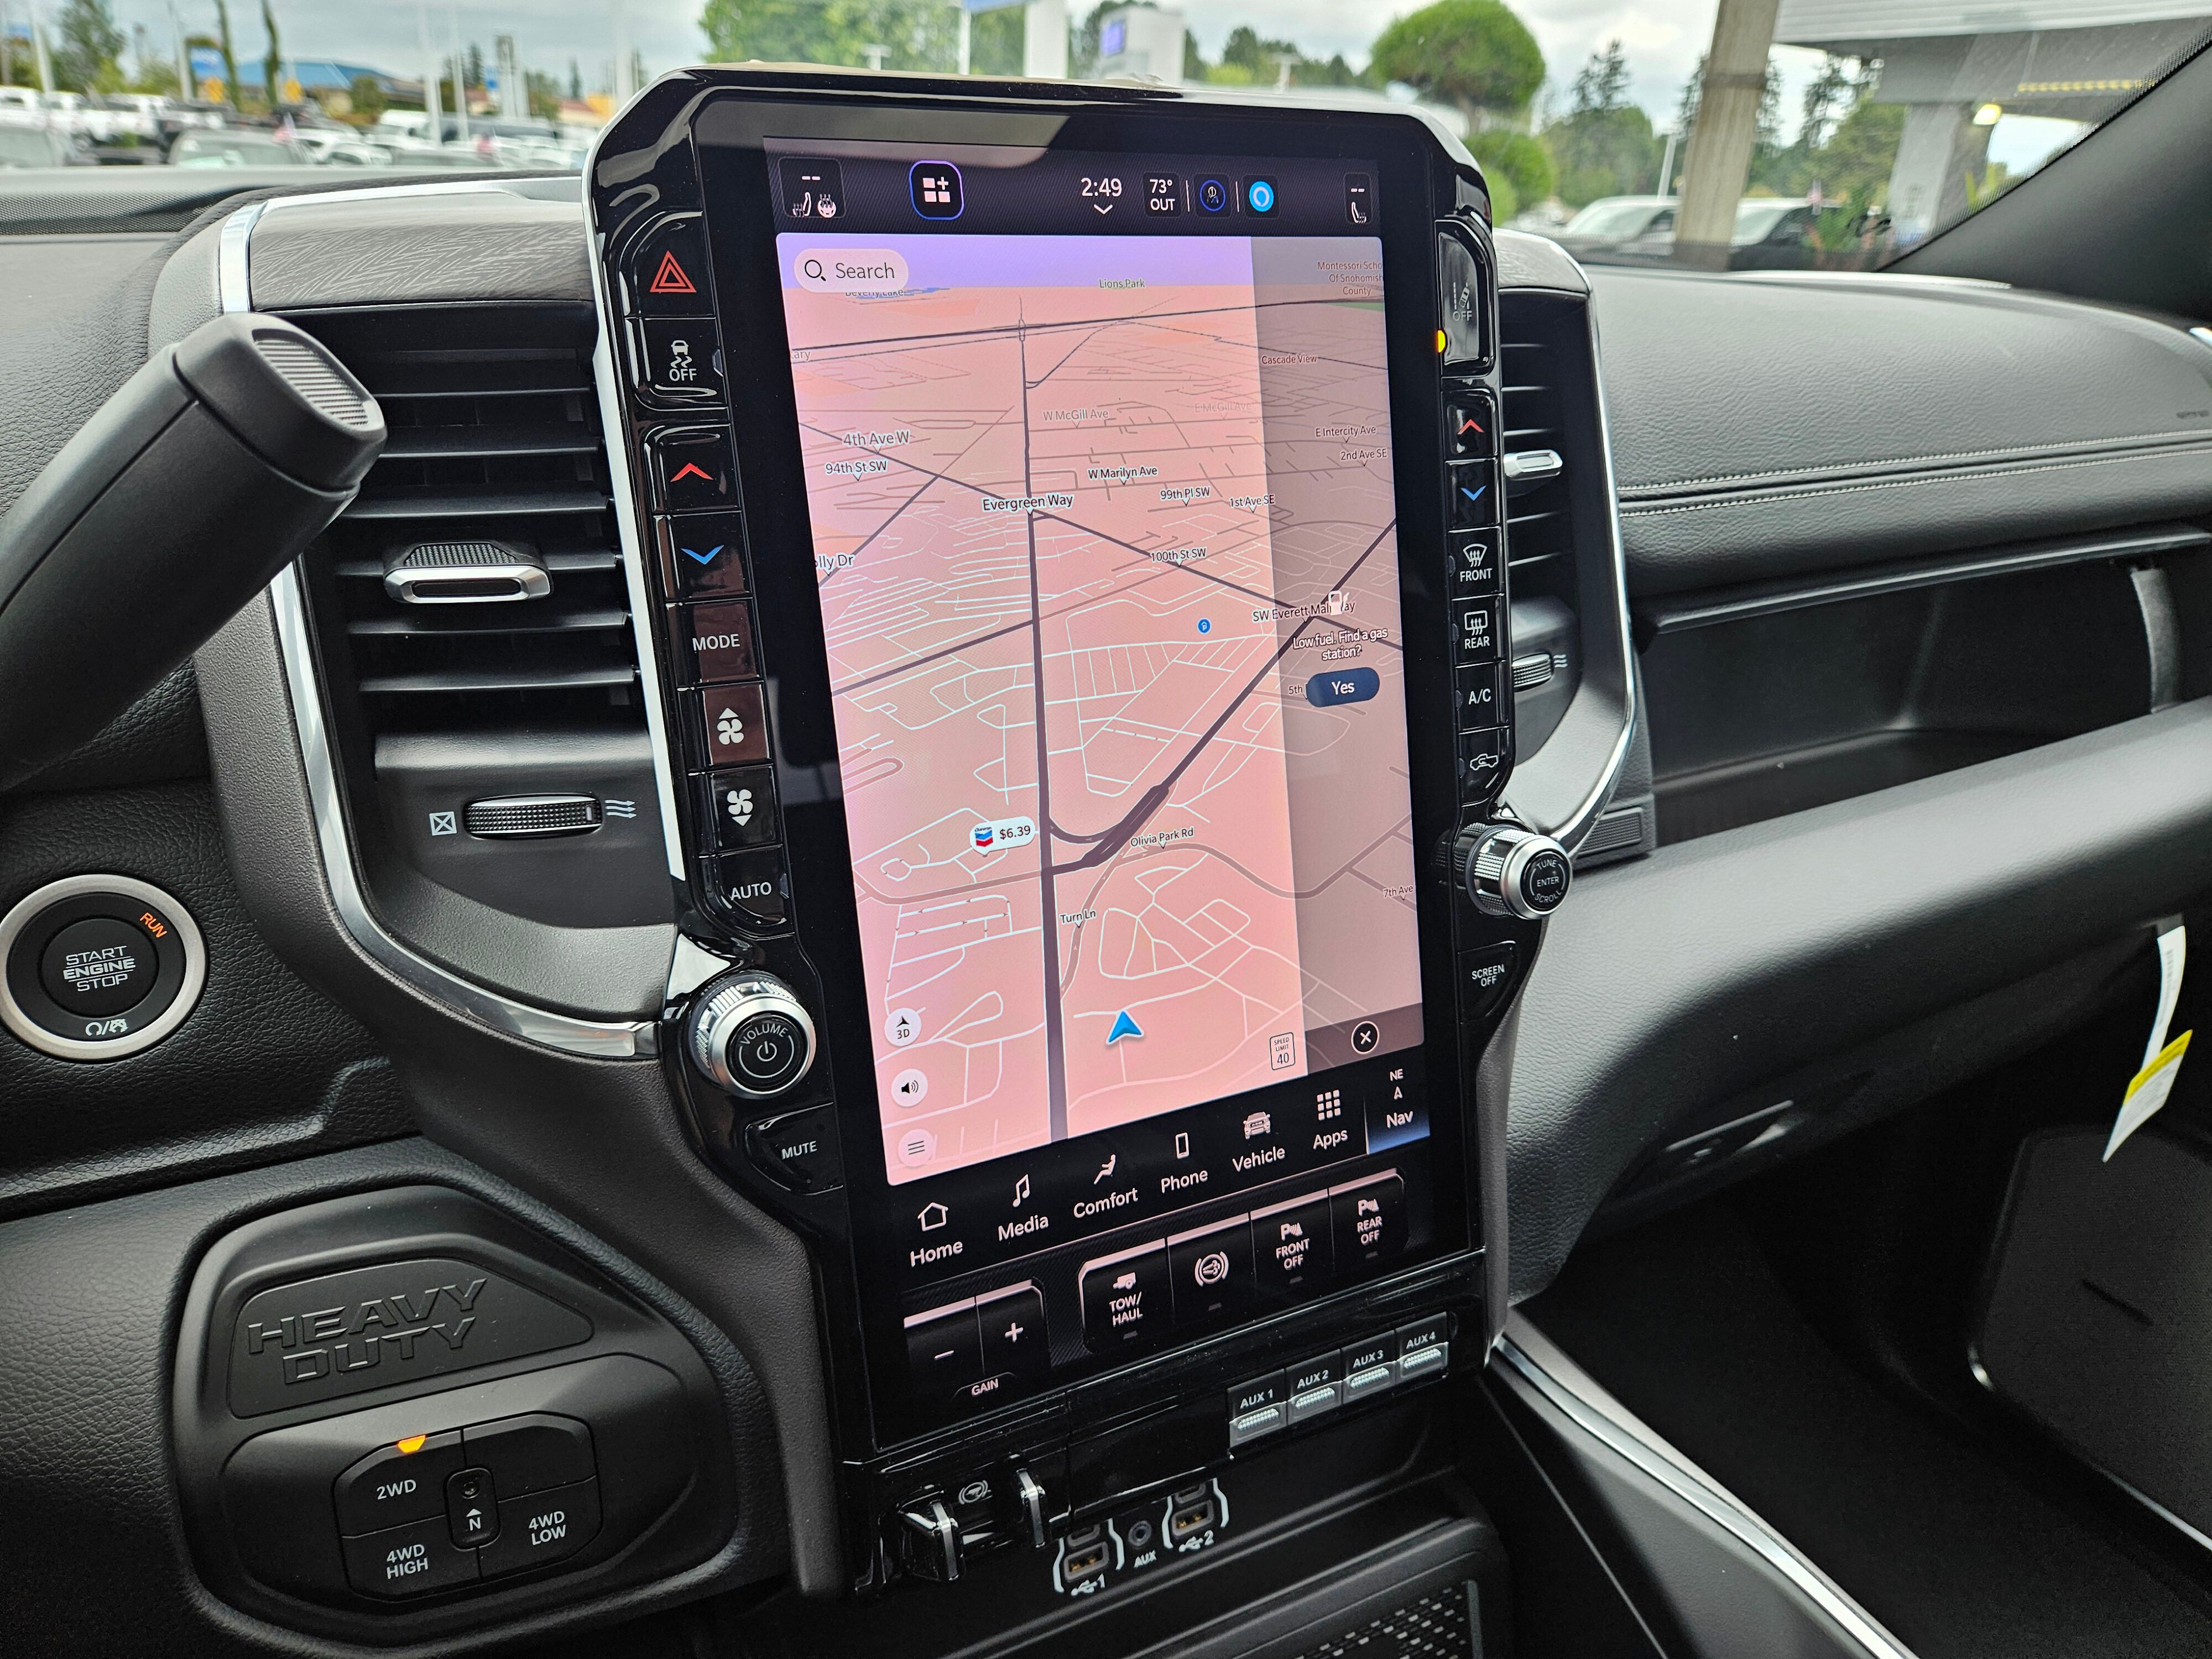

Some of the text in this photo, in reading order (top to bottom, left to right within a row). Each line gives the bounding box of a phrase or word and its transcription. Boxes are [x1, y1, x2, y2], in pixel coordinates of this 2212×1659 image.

[1081, 178, 1122, 197] 2:49
[1150, 198, 1175, 211] OUT
[836, 262, 895, 279] Search
[1318, 261, 1361, 270] Montessori
[1099, 278, 1145, 288] Lions Park
[1329, 274, 1339, 283] Of
[1343, 286, 1371, 296] County
[1453, 310, 1472, 322] OFF
[1262, 354, 1317, 364] Cascade View
[669, 368, 697, 382] OFF
[1044, 409, 1109, 421] W McGill Ave
[843, 431, 909, 445] 4th Ave W
[1316, 425, 1376, 439] E Intercity Ave
[1341, 448, 1387, 460] 2nd Ave SE
[826, 461, 887, 474] 94th St SW
[1088, 466, 1157, 479] W Marilyn Ave
[1161, 487, 1210, 499] 99th Pl SW
[1230, 494, 1275, 507] 1st Ave SE
[983, 494, 1073, 512] Evergreen Way
[838, 554, 853, 566] Dr
[1151, 548, 1207, 562] 100th St SW
[1459, 568, 1493, 583] FRONT
[1253, 611, 1269, 622] SW
[1272, 606, 1308, 620] Everett
[692, 634, 740, 651] MODE
[1293, 628, 1388, 649] Low fuel. Find a gas
[1464, 636, 1490, 649] REAR
[1322, 644, 1362, 661] station?
[1289, 685, 1303, 695] 5th
[1332, 680, 1355, 695] Yes
[1468, 688, 1491, 705] A/C
[999, 825, 1031, 840] $6.39
[1130, 827, 1194, 847] Olivia Park Rd
[1536, 859, 1557, 870] TUNE
[1536, 875, 1560, 887] ENTER
[730, 882, 772, 901] AUTO
[1383, 885, 1413, 898] 7th Ave
[1534, 890, 1563, 903] SCROLL
[139, 911, 168, 938] RUN
[1060, 910, 1096, 924] Turn Ln
[66, 945, 128, 966] START
[62, 958, 136, 980] ENGINE
[1472, 964, 1505, 980] SCREEN
[76, 973, 128, 992] STOP
[1480, 975, 1497, 987] OFF
[740, 1022, 789, 1046] VOLUME
[897, 1029, 910, 1040] 3D
[1274, 1037, 1290, 1045] SPEED
[1275, 1044, 1288, 1052] LIMIT
[1277, 1052, 1289, 1065] 40
[1390, 1068, 1404, 1081] NE
[1386, 1110, 1413, 1129] Nav
[1313, 1130, 1348, 1150] Apps
[781, 1140, 818, 1160] MUTE
[1232, 1146, 1286, 1172] Vehicle
[1161, 1169, 1208, 1193] Phone
[1073, 1187, 1139, 1218] Comfort
[998, 1214, 1049, 1241] Media
[1357, 1216, 1383, 1233] REAR
[1361, 1230, 1380, 1245] OFF
[910, 1240, 963, 1267] Home
[1276, 1238, 1310, 1259] FRONT
[1284, 1254, 1303, 1270] OFF
[1109, 1291, 1142, 1312] TOW/
[248, 1277, 488, 1355] HEAVY
[1112, 1307, 1143, 1327] HAUL
[1406, 1331, 1436, 1349] AUX 4
[283, 1316, 476, 1384] DUTY
[1353, 1349, 1384, 1369] AUX 3
[971, 1378, 999, 1396] GAIN
[1297, 1369, 1329, 1389] AUX 2
[1240, 1388, 1274, 1409] AUX 1
[376, 1478, 417, 1500] 2WD
[468, 1516, 481, 1531] N
[529, 1510, 565, 1531] 4WD
[531, 1525, 567, 1546] LOW
[1204, 1530, 1214, 1545] 2
[387, 1543, 425, 1564] 4WD
[1134, 1550, 1156, 1568] AUX
[387, 1557, 429, 1579] HIGH
